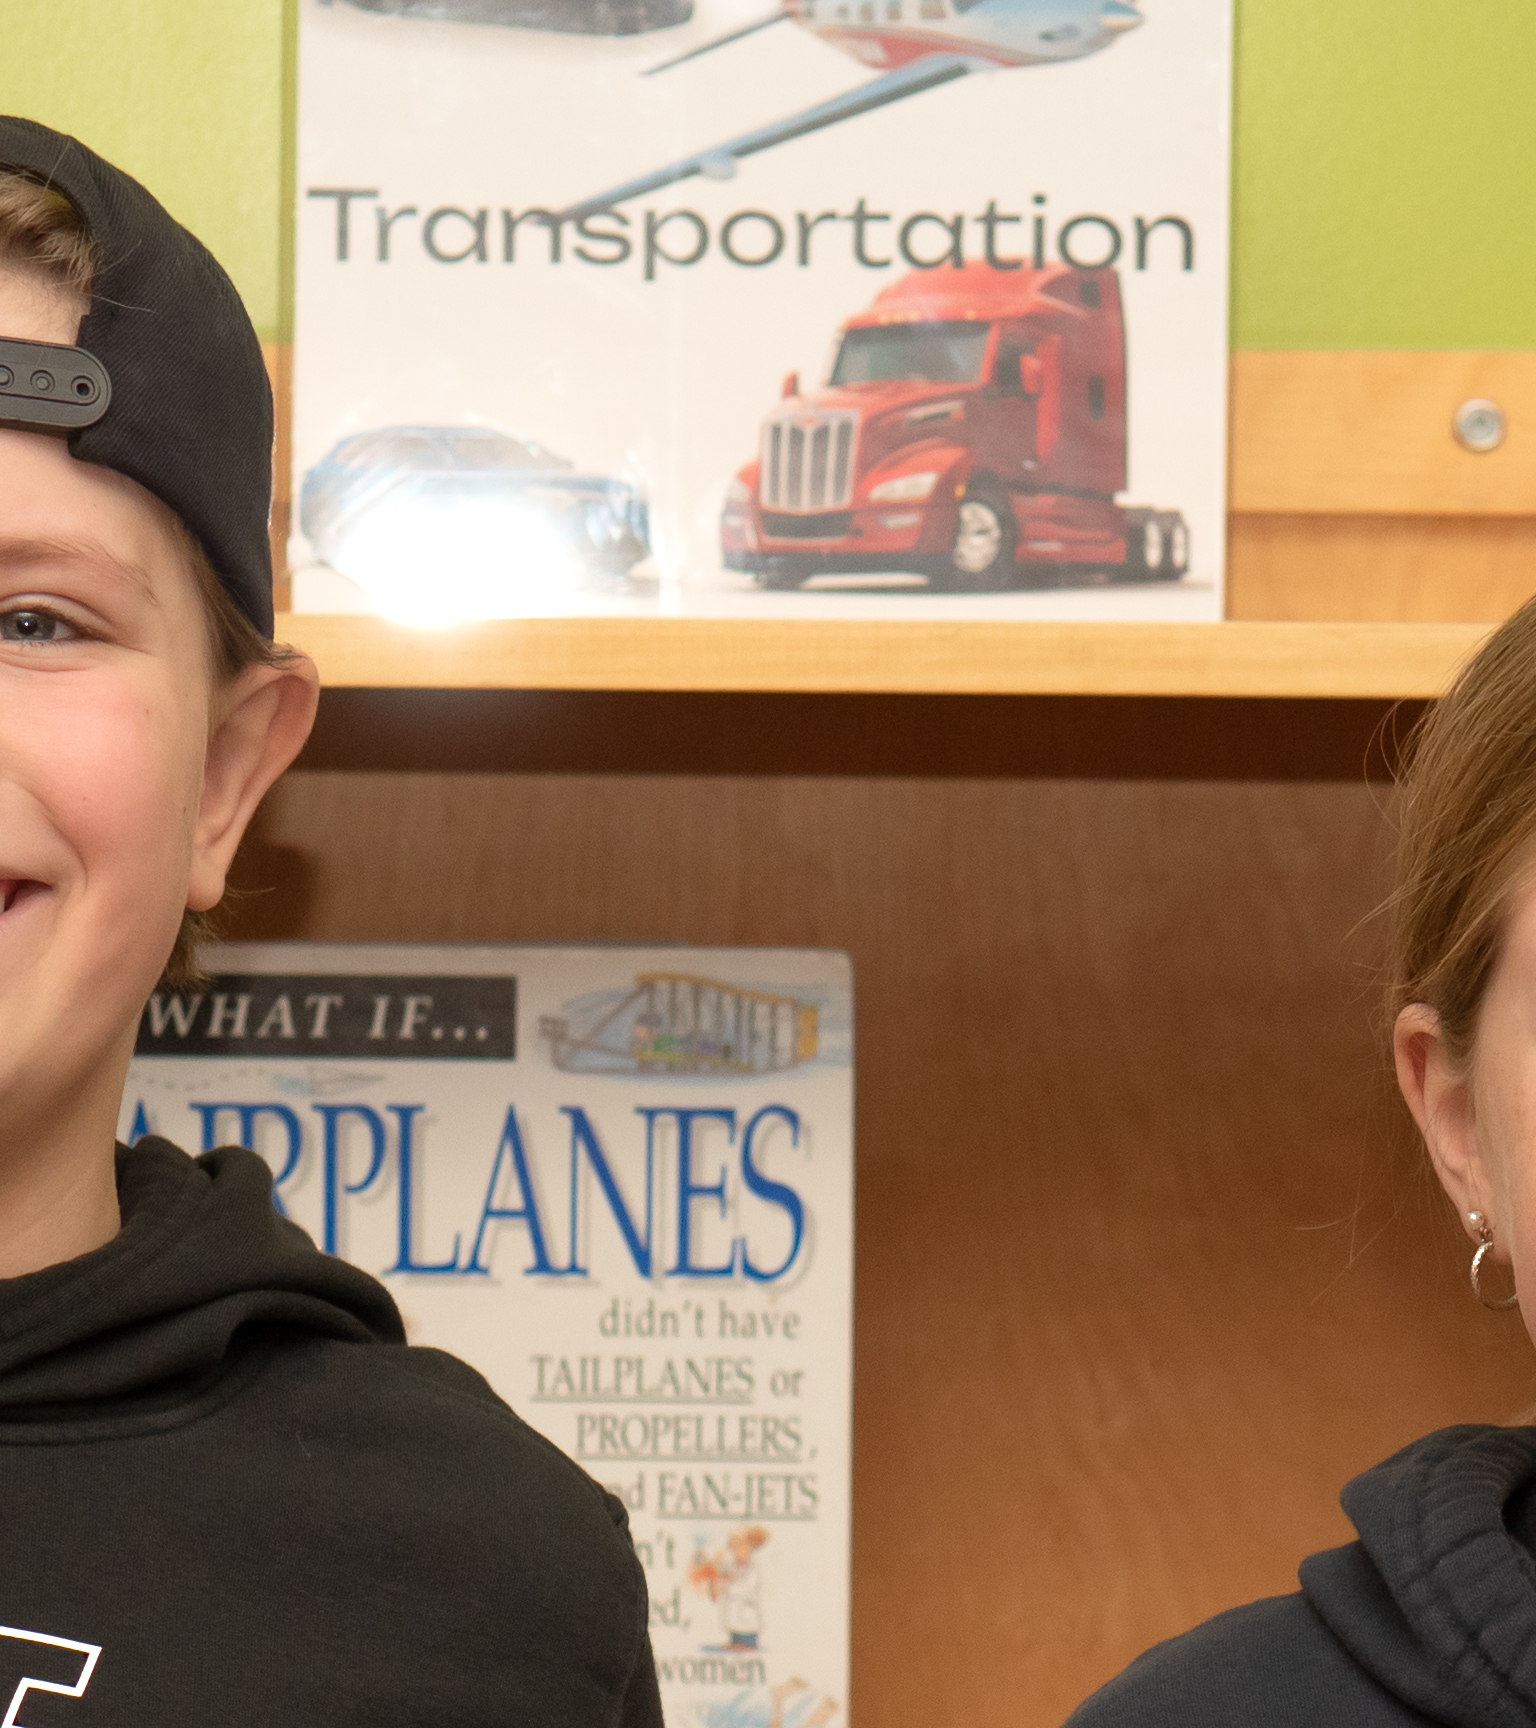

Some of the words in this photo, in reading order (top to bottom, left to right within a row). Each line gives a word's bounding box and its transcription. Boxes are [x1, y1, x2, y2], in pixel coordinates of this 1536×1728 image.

[305, 186, 1196, 281] Transportation
[147, 994, 343, 1040] WHAT
[368, 995, 492, 1043] IF...
[598, 1297, 706, 1339] didn't
[717, 1300, 801, 1340] have
[530, 1354, 755, 1396] TAILPLANES
[769, 1368, 805, 1398] or
[657, 1472, 819, 1514] FAN-JETS
[654, 1656, 766, 1686] women
